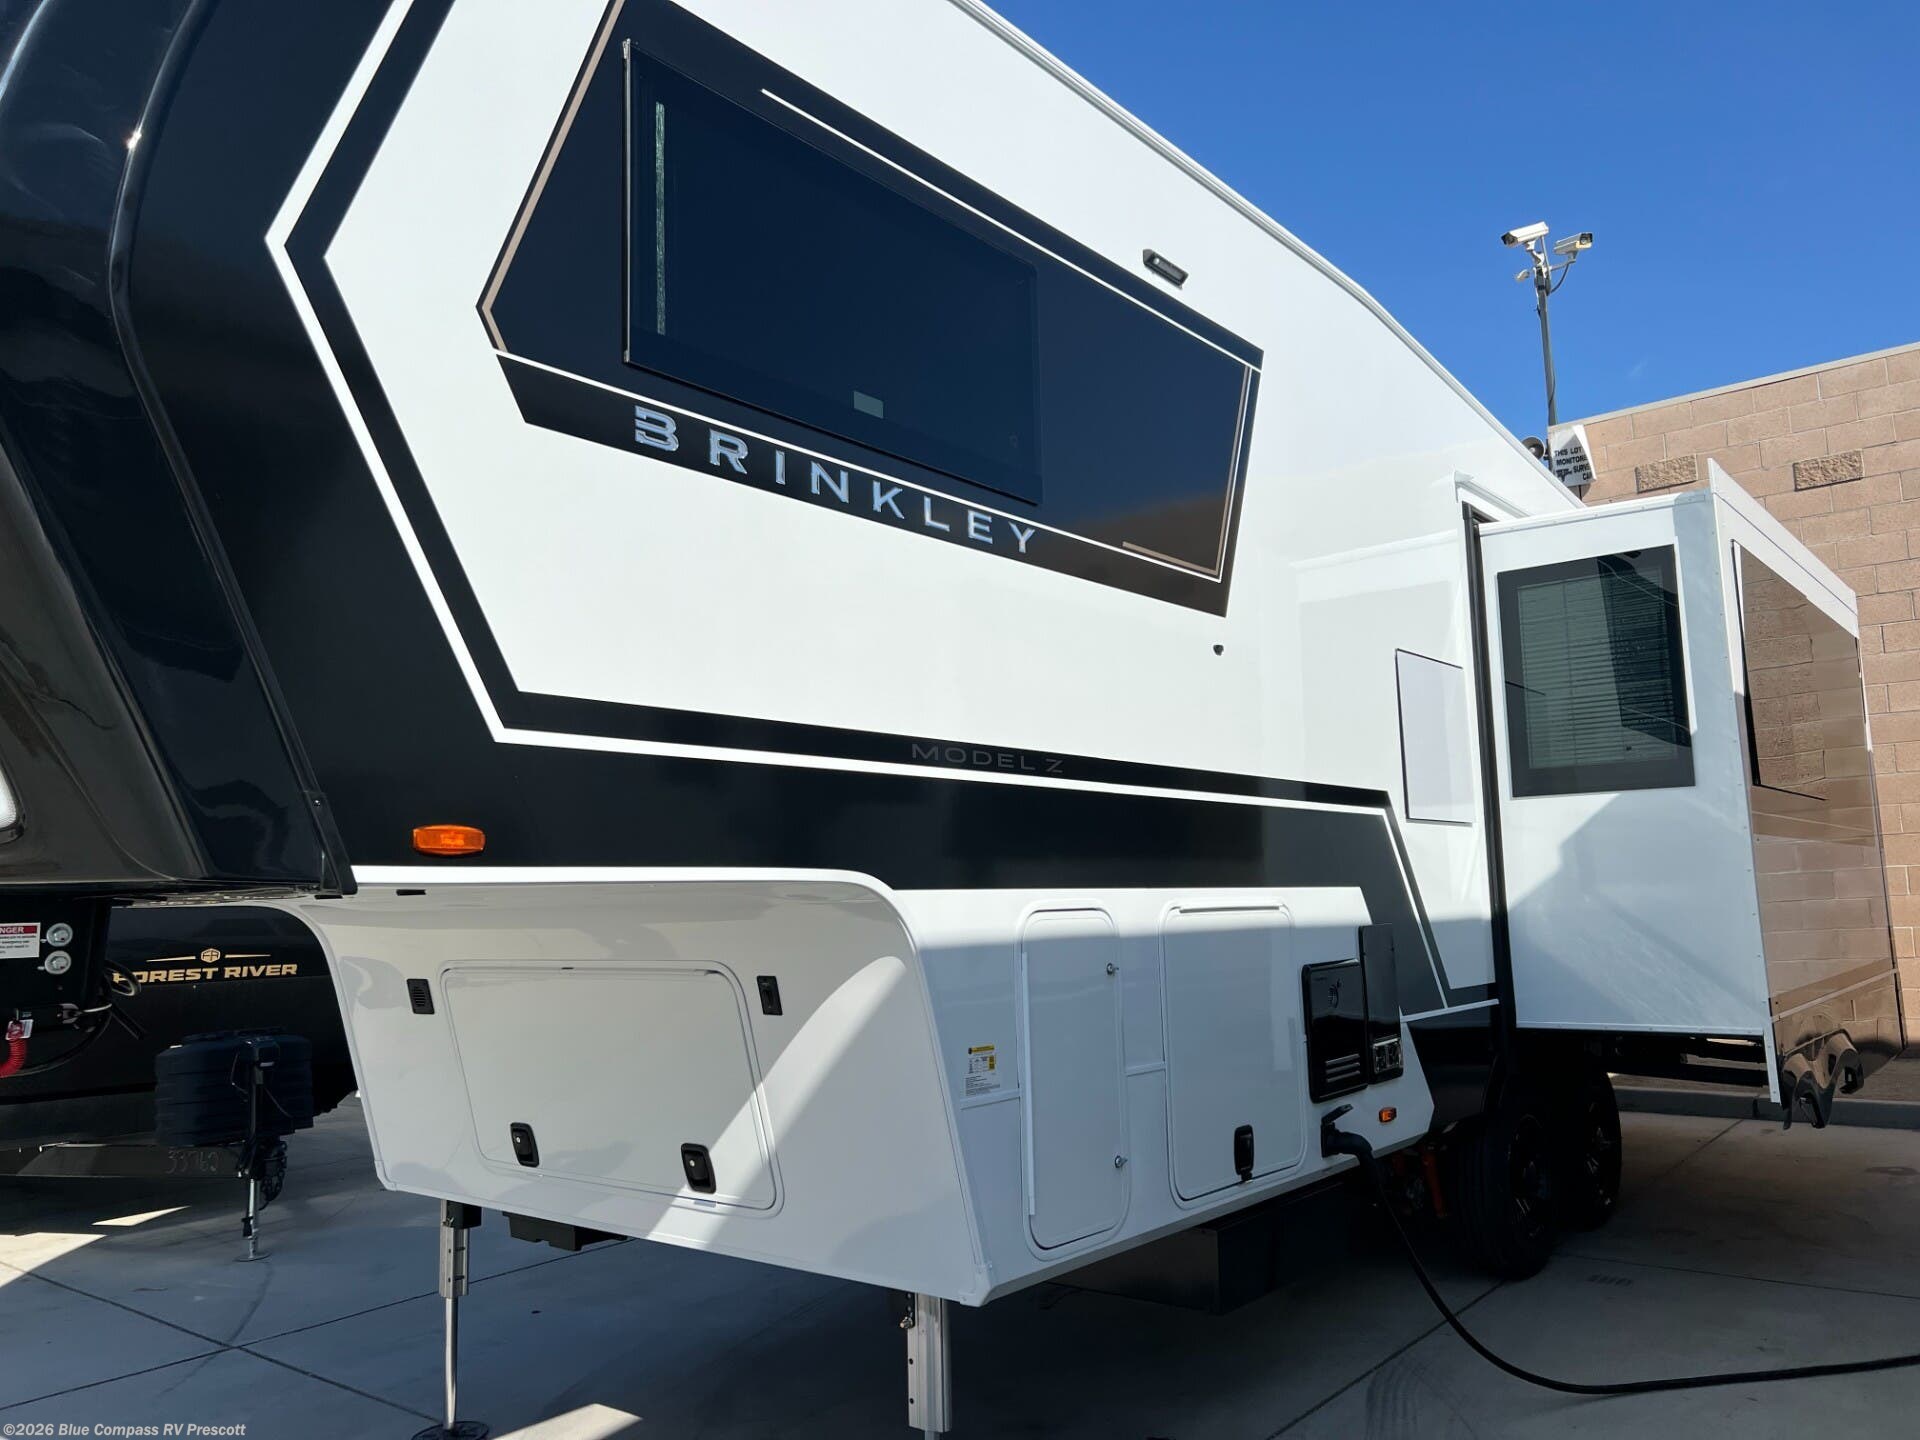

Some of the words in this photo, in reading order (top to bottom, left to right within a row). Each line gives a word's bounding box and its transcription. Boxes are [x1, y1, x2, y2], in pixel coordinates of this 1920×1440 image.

[1554, 449, 1568, 457] THIS
[1570, 446, 1582, 454] LOT
[634, 405, 1036, 554] BRINKLEY
[911, 743, 1036, 771] MODEL
[1045, 758, 1063, 773] Z
[223, 963, 298, 979] RIVER
